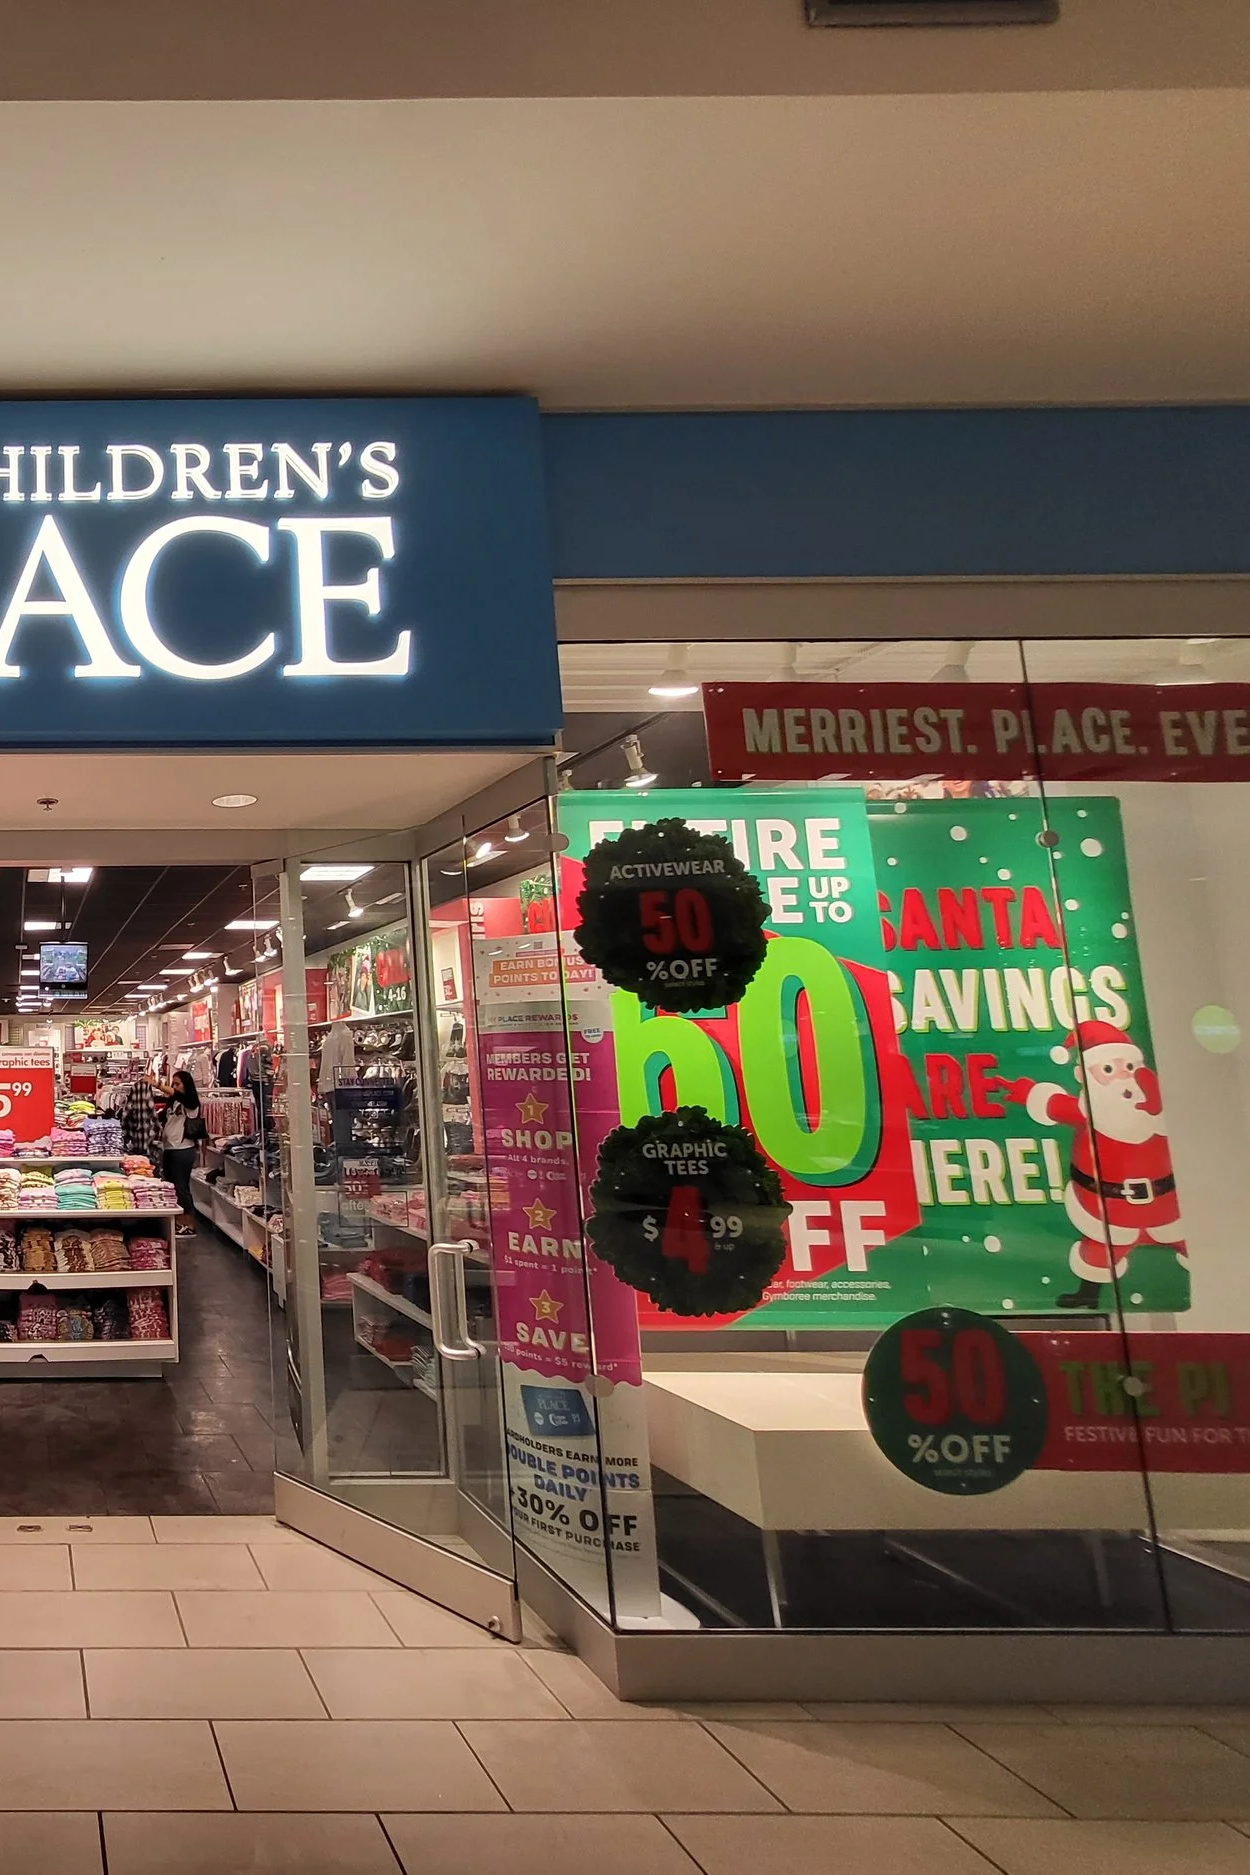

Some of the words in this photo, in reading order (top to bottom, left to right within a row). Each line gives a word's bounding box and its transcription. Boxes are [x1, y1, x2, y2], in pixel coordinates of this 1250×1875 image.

[742, 706, 978, 754] MERRIEST.
[991, 707, 1149, 755] PLACE.
[1158, 709, 1250, 757] EVE
[610, 859, 725, 881] ACTIVEWEAR
[808, 876, 850, 900] UP
[470, 901, 486, 940] irls
[639, 887, 714, 955] 50
[809, 901, 853, 924] TO
[500, 959, 534, 971] EARN
[646, 958, 718, 981] %OFF
[493, 973, 538, 985] POINTS
[388, 986, 407, 1001] 4-16
[498, 1014, 524, 1023] PLACE
[30, 1058, 50, 1067] tees
[486, 1053, 552, 1065] MEMBERS
[555, 1052, 590, 1065] GET
[487, 1067, 591, 1082] REWARDED!
[527, 1105, 535, 1116] 1
[501, 1128, 572, 1150] SHOP
[642, 1141, 727, 1159] GRAPHIC
[664, 1160, 709, 1176] TEES
[534, 1210, 544, 1222] 2
[507, 1231, 583, 1259] EARN
[788, 1200, 886, 1272] FF
[515, 1259, 539, 1271] spent
[786, 1280, 829, 1290] footwear,
[542, 1301, 551, 1314] 3
[762, 1291, 810, 1303] Gymboree
[812, 1291, 878, 1302] merchandise.
[516, 1321, 590, 1353] SAVE
[516, 1347, 542, 1361] points
[901, 1329, 1007, 1426] 50
[1059, 1361, 1161, 1418] THE
[1064, 1426, 1138, 1442] FESTIVE
[1144, 1426, 1187, 1444] FUN
[1191, 1428, 1233, 1444] FOR
[507, 1428, 564, 1457] ARDHOLDERS
[566, 1451, 599, 1464] EARN
[605, 1456, 639, 1467] MORE
[908, 1434, 1011, 1464] %OFF
[561, 1464, 640, 1489] POINTS
[530, 1517, 562, 1538] FIRST
[579, 1509, 638, 1536] OFF
